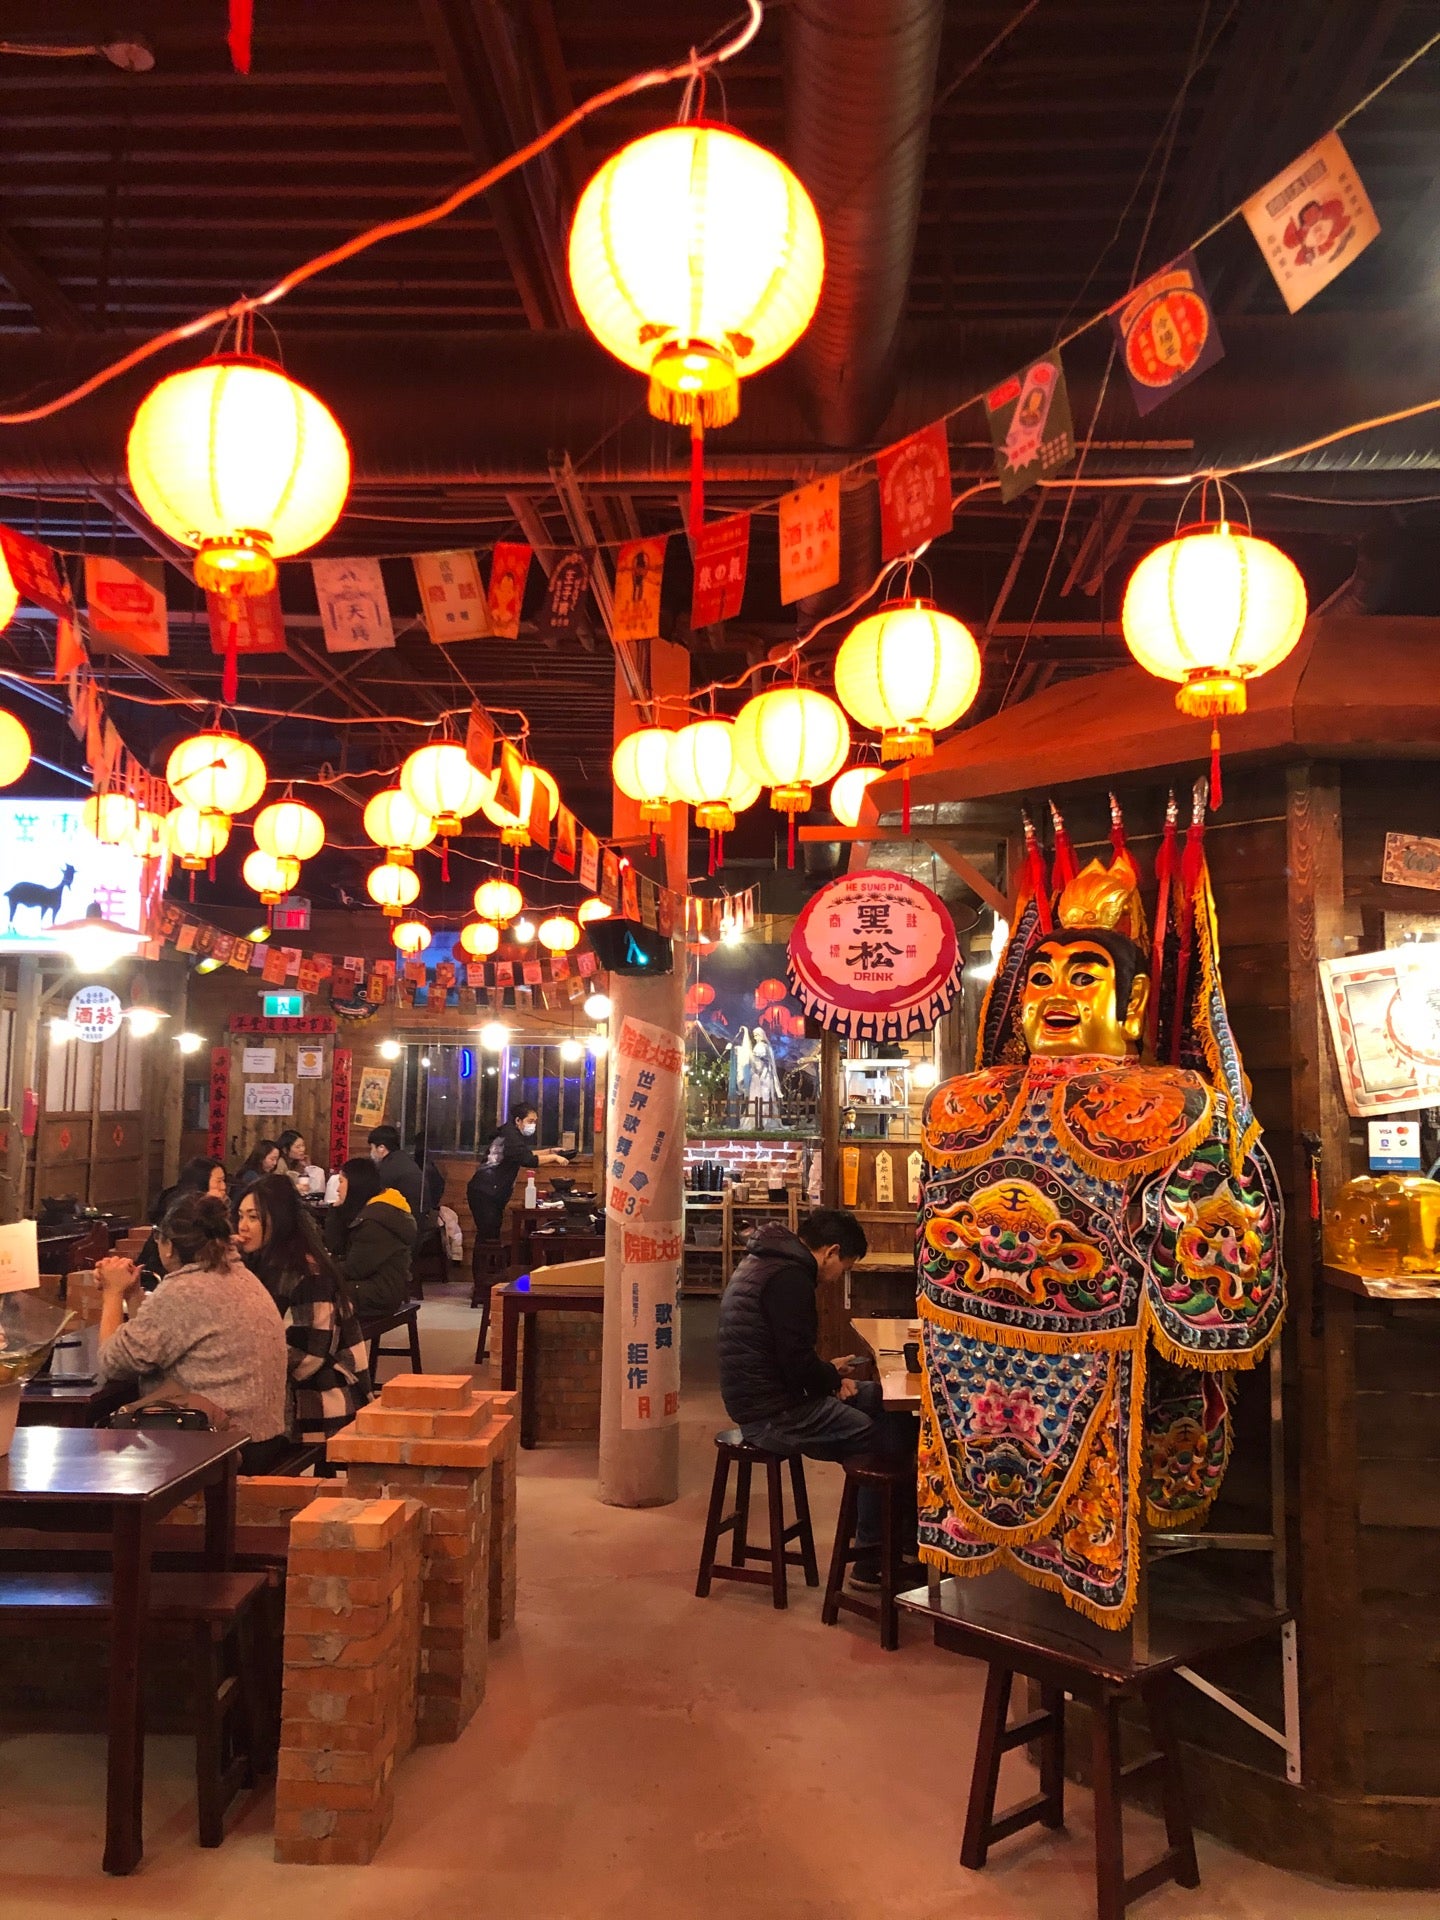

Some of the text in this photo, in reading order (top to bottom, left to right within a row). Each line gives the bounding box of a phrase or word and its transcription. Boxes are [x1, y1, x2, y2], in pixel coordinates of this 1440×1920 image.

[845, 883, 858, 891] HE
[861, 883, 886, 891] SUNG
[845, 904, 904, 970] 黑松
[853, 972, 894, 981] DRINK
